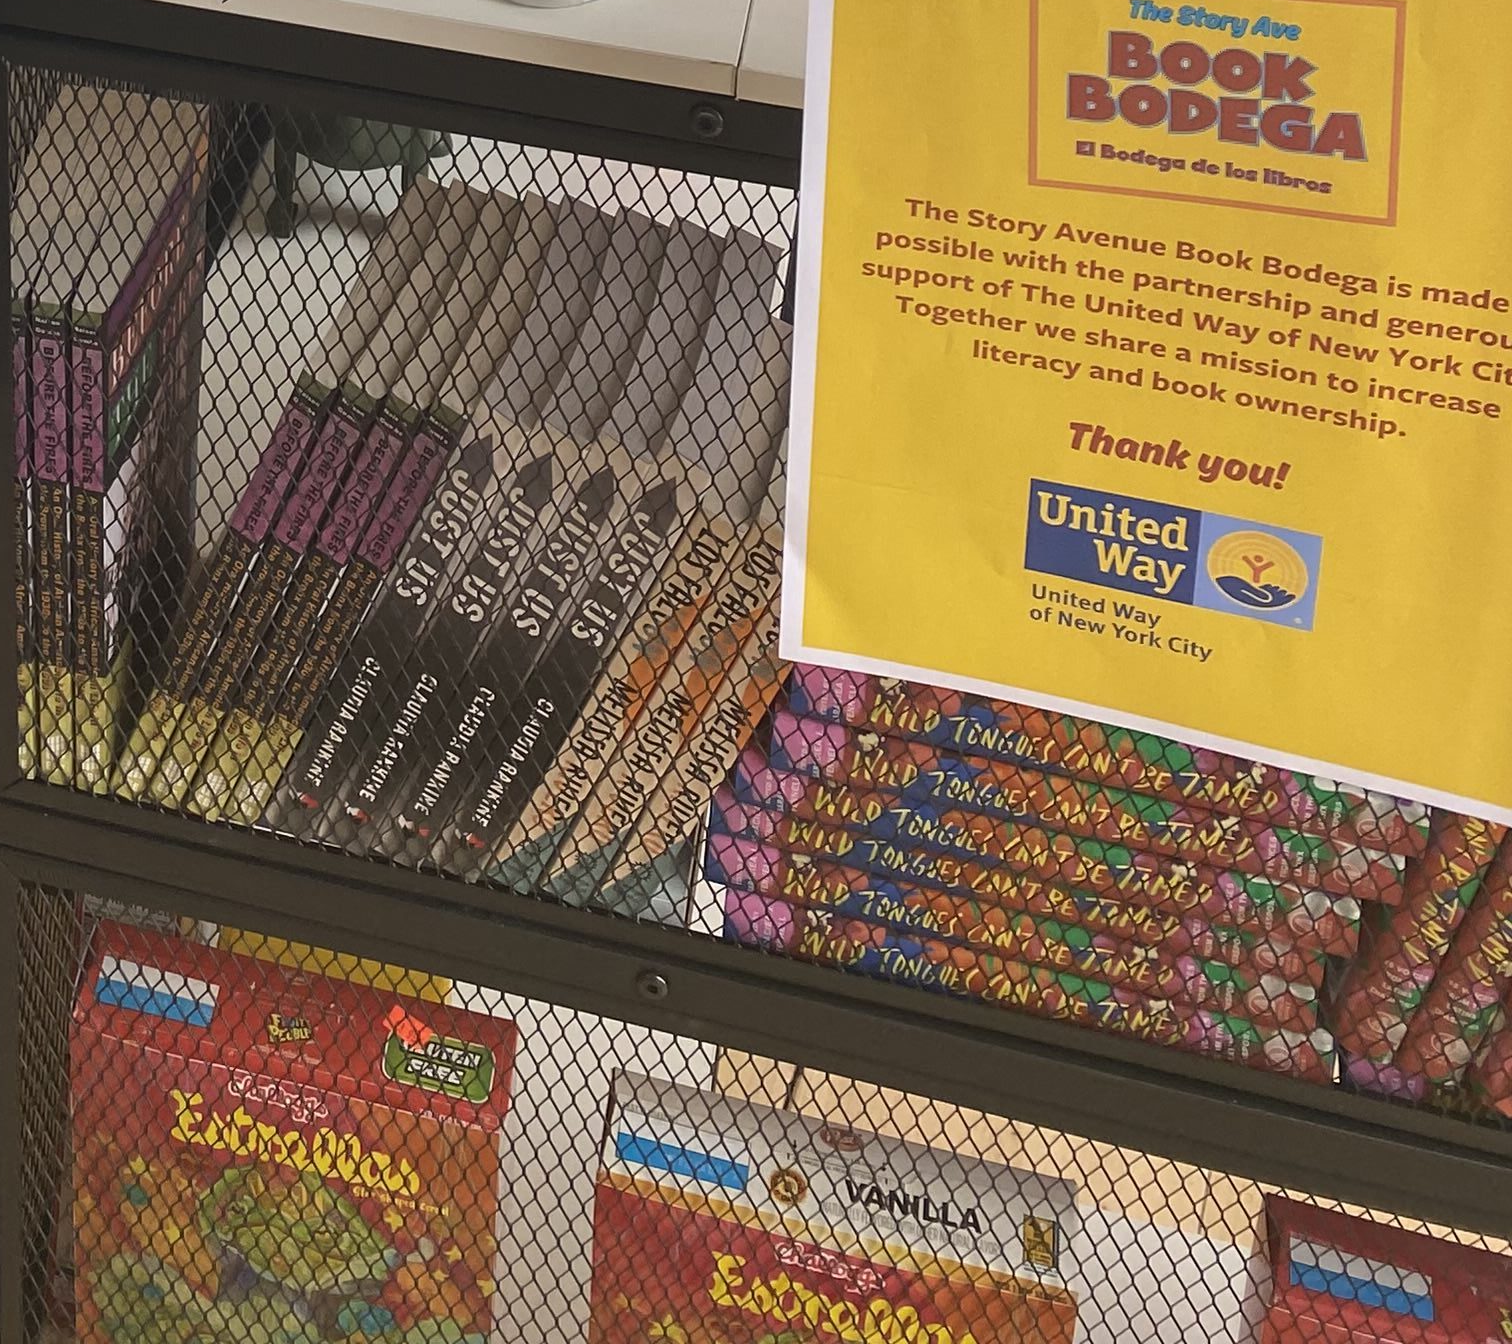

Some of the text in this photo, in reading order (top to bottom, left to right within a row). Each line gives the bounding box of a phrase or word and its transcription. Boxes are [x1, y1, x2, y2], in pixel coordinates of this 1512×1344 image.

[1177, 5, 1249, 39] Story
[1252, 16, 1302, 41] Ave
[1107, 30, 1320, 102] BOOK
[1066, 72, 1368, 162] BODEGA
[1100, 143, 1186, 172] Bodega
[1191, 158, 1219, 176] de
[1225, 162, 1258, 182] los
[1263, 167, 1332, 194] libros
[876, 231, 1512, 349] possible with the partnership and generou
[904, 198, 1510, 313] The Story Avenue Book Bodega is made
[861, 258, 1512, 387] support of The United Way of New York Cit
[896, 295, 1501, 419] Together we share a mission to increase
[972, 339, 1406, 439] literacy and book ownership.
[1069, 421, 1291, 490] Thank you!
[1037, 490, 1189, 551] United
[1093, 538, 1186, 594] Way
[1030, 607, 1213, 662] of New York City
[1032, 583, 1162, 628] United Way
[844, 1178, 982, 1234] VANILLA
